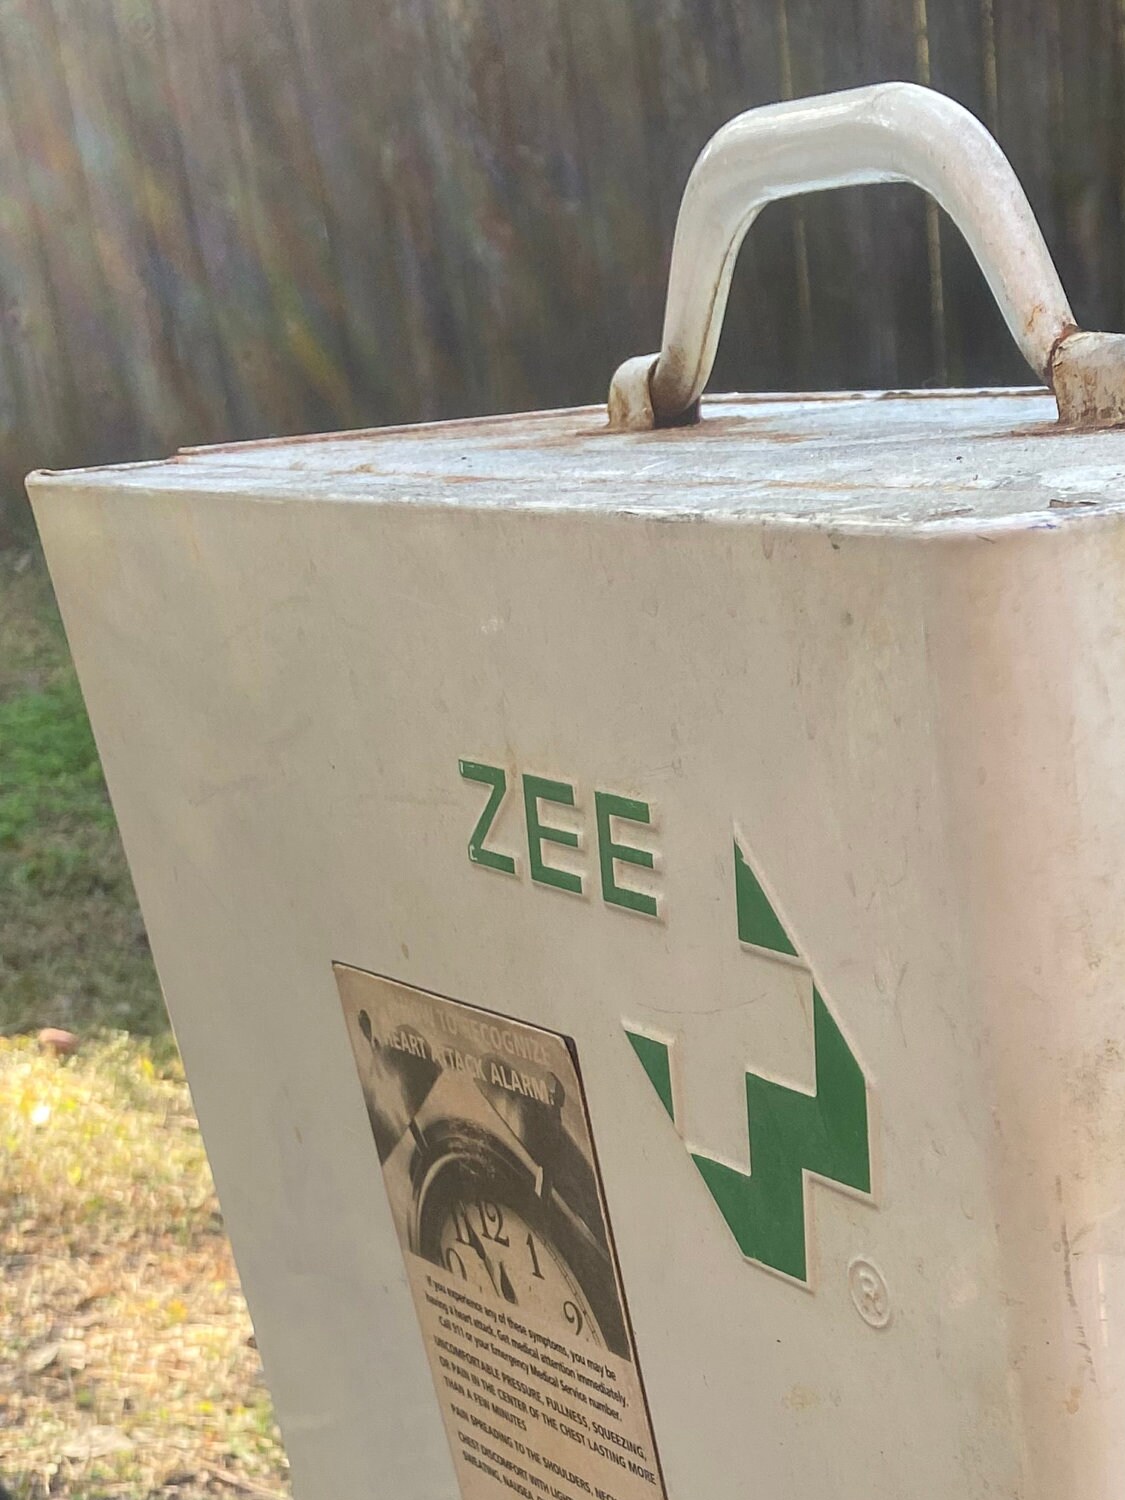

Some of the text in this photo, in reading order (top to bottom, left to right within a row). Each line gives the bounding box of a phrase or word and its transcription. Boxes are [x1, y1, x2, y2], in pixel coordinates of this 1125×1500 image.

[457, 758, 657, 917] ZEE
[427, 1042, 486, 1080] ATTACK
[436, 1010, 459, 1033] TO
[479, 1203, 511, 1248] 12
[425, 1291, 450, 1314] having
[454, 1305, 472, 1324] heart
[496, 1328, 511, 1344] Get
[510, 1335, 539, 1358] medical
[540, 1351, 576, 1377] attention
[576, 1369, 630, 1410] immediately.
[438, 1315, 452, 1330] Call
[452, 1322, 464, 1337] 911
[474, 1336, 491, 1354] your
[490, 1343, 531, 1376] Emergency
[530, 1363, 560, 1388] Medical
[559, 1379, 587, 1402] Service
[588, 1394, 622, 1421] number.
[447, 1286, 483, 1313] experience
[484, 1306, 498, 1323] any
[497, 1310, 506, 1324] of
[507, 1316, 527, 1335] these
[528, 1327, 570, 1359] symptoms,
[569, 1350, 586, 1368] you
[586, 1358, 606, 1378] may
[605, 1365, 617, 1380] be
[434, 1335, 647, 1461] UNCOMFORTABLE PRESSURE, FULLNESS, SQUEEZING,
[439, 1356, 657, 1485] OR PAIN IN THE CENTER OF THE CHEST LASTING MORE
[444, 1375, 465, 1396] THAN
[474, 1392, 491, 1410] FEW
[491, 1403, 527, 1431] MINUTES
[451, 1403, 470, 1422] PAIN
[470, 1414, 513, 1447] SPREADING
[514, 1440, 525, 1454] TO
[526, 1447, 542, 1464] THE
[543, 1457, 594, 1496] SHOULDERS,
[458, 1430, 481, 1453] CHEST
[480, 1444, 529, 1481] DISCOMFORT
[529, 1473, 549, 1494] WITH
[463, 1450, 502, 1482] SWEATING,
